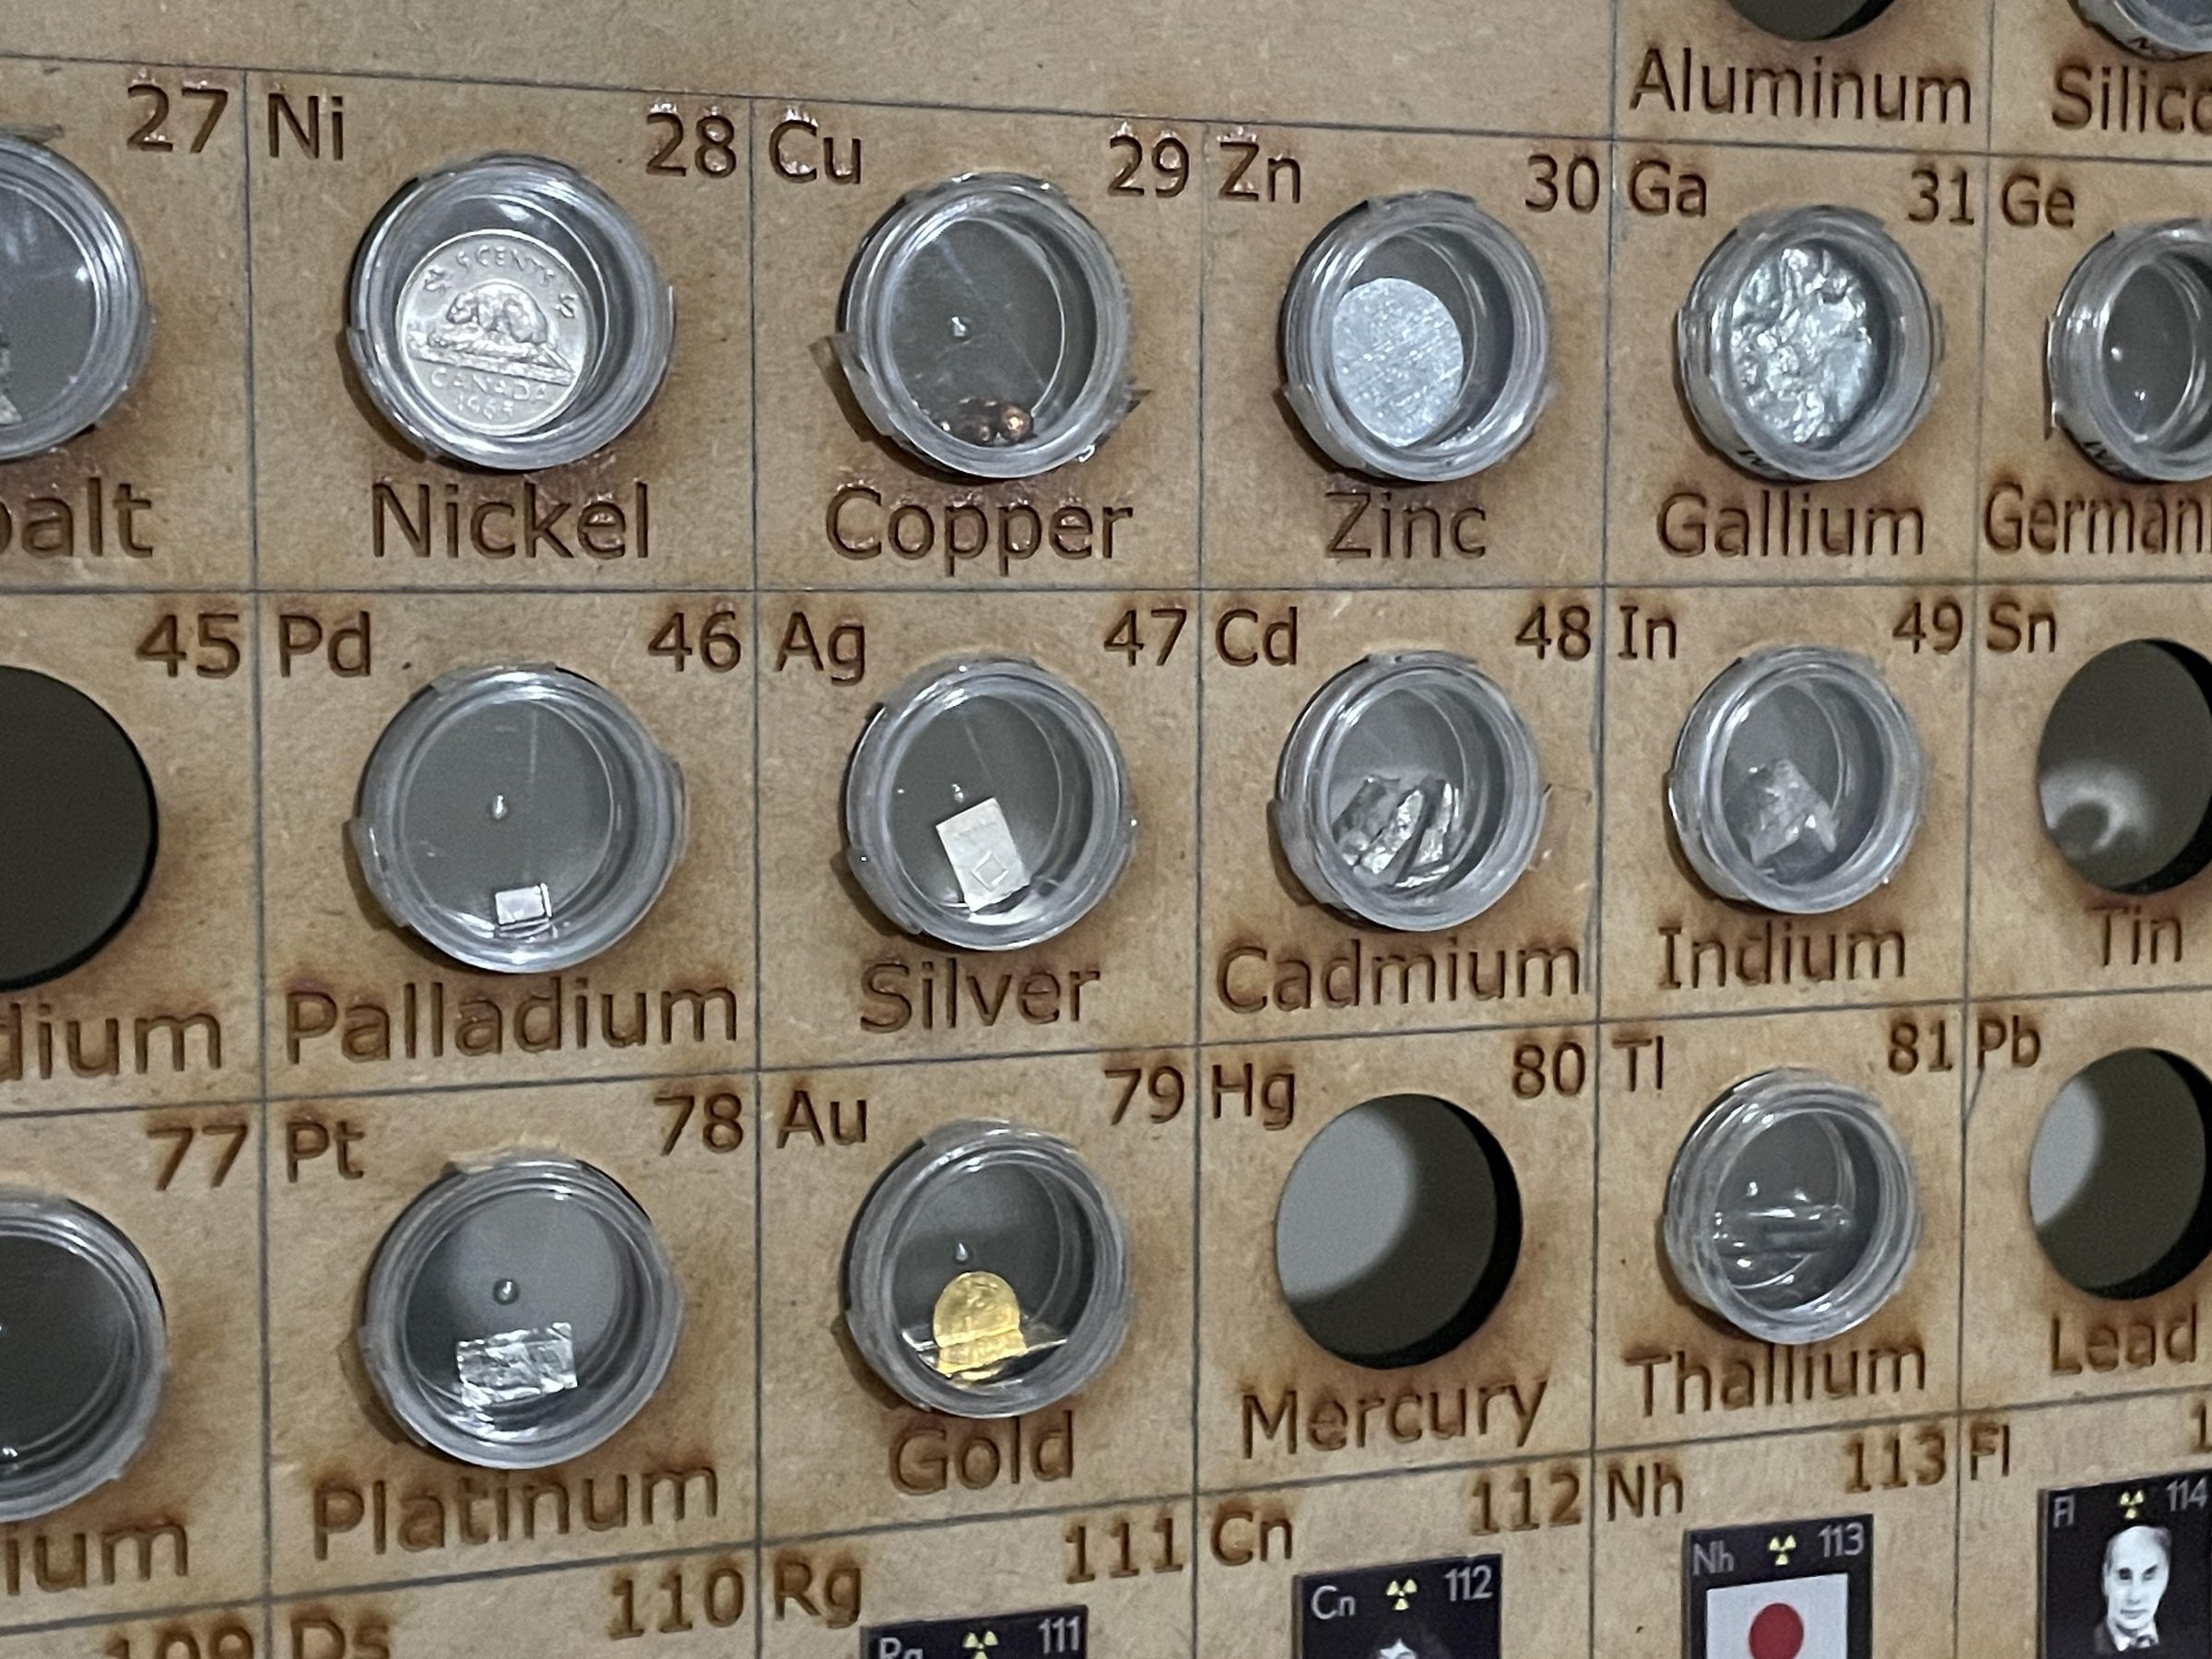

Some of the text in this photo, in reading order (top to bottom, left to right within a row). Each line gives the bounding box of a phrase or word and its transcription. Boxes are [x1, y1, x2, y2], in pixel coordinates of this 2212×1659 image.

[125, 83, 229, 154] 27
[1629, 47, 1971, 124] Aluminum
[266, 92, 735, 178] Ni 28
[767, 117, 1190, 198] Cu 29
[1218, 139, 1601, 214] Zn 30
[1627, 159, 1975, 227] Ga 31
[2000, 172, 2076, 229] Ge
[0, 477, 154, 559] alt
[371, 479, 649, 560] Nickel
[825, 485, 1135, 578] Copper
[1324, 489, 1486, 559] Zinc
[1658, 489, 1924, 558] Gallium
[1983, 482, 2212, 554] German
[136, 613, 241, 679] 45
[278, 610, 739, 678] Pd 46
[773, 608, 1188, 686] Ag 47
[1214, 605, 1592, 667] Cd 48
[1618, 601, 1965, 661] In 49
[1986, 601, 2058, 653] Sn
[1657, 924, 1906, 991] Indium
[2085, 905, 2183, 969] Tin
[859, 956, 1100, 1034] Silver
[1215, 940, 1581, 1014] Cadmium
[285, 976, 739, 1065] Palladium
[1611, 1018, 1953, 1093] Tl 81
[1977, 1014, 2042, 1069] Pb
[776, 1066, 1185, 1149] Au 79
[1210, 1041, 1585, 1132] Hg 80
[147, 1122, 249, 1192] 77
[286, 1092, 741, 1183] Pt 78
[2051, 1302, 2197, 1375] Lead
[1241, 1374, 1548, 1459] Mercury
[1623, 1341, 1926, 1418] Thallium
[888, 1408, 1074, 1497] Gold
[1606, 1430, 1947, 1522] Nh 113
[1970, 1424, 2010, 1480] Fl
[312, 1465, 719, 1561] Platinum
[1209, 1475, 1582, 1567] Cn 112
[2168, 1477, 2207, 1512] 114
[772, 1518, 1184, 1630] Rg 111
[1691, 1522, 1865, 1579] Nh 113
[290, 1567, 745, 1659] Ds 110
[1311, 1566, 1493, 1619] Cn 112
[1039, 1616, 1080, 1654] 111
